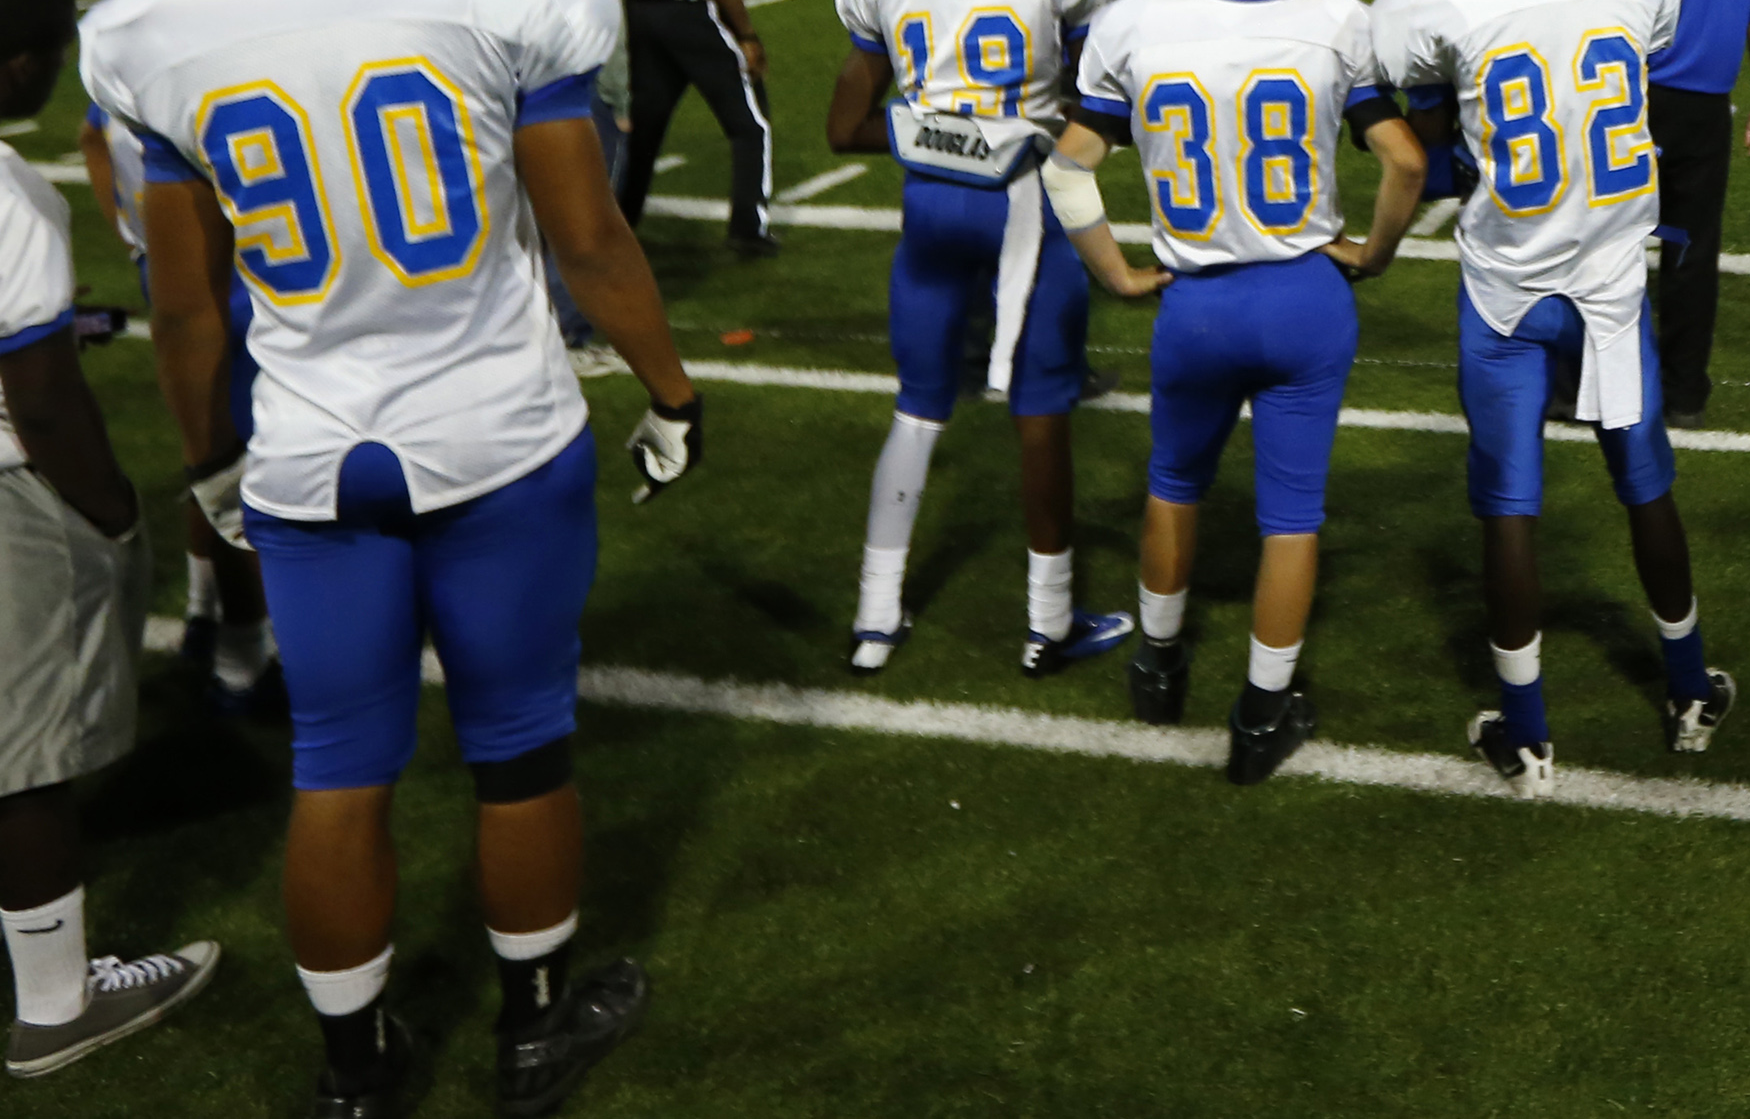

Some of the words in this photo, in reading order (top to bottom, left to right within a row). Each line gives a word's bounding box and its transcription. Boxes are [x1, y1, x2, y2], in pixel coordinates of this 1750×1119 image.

[894, 5, 1034, 119] 19
[1475, 26, 1658, 218] 82
[195, 55, 491, 306] 90
[1138, 68, 1319, 242] 38
